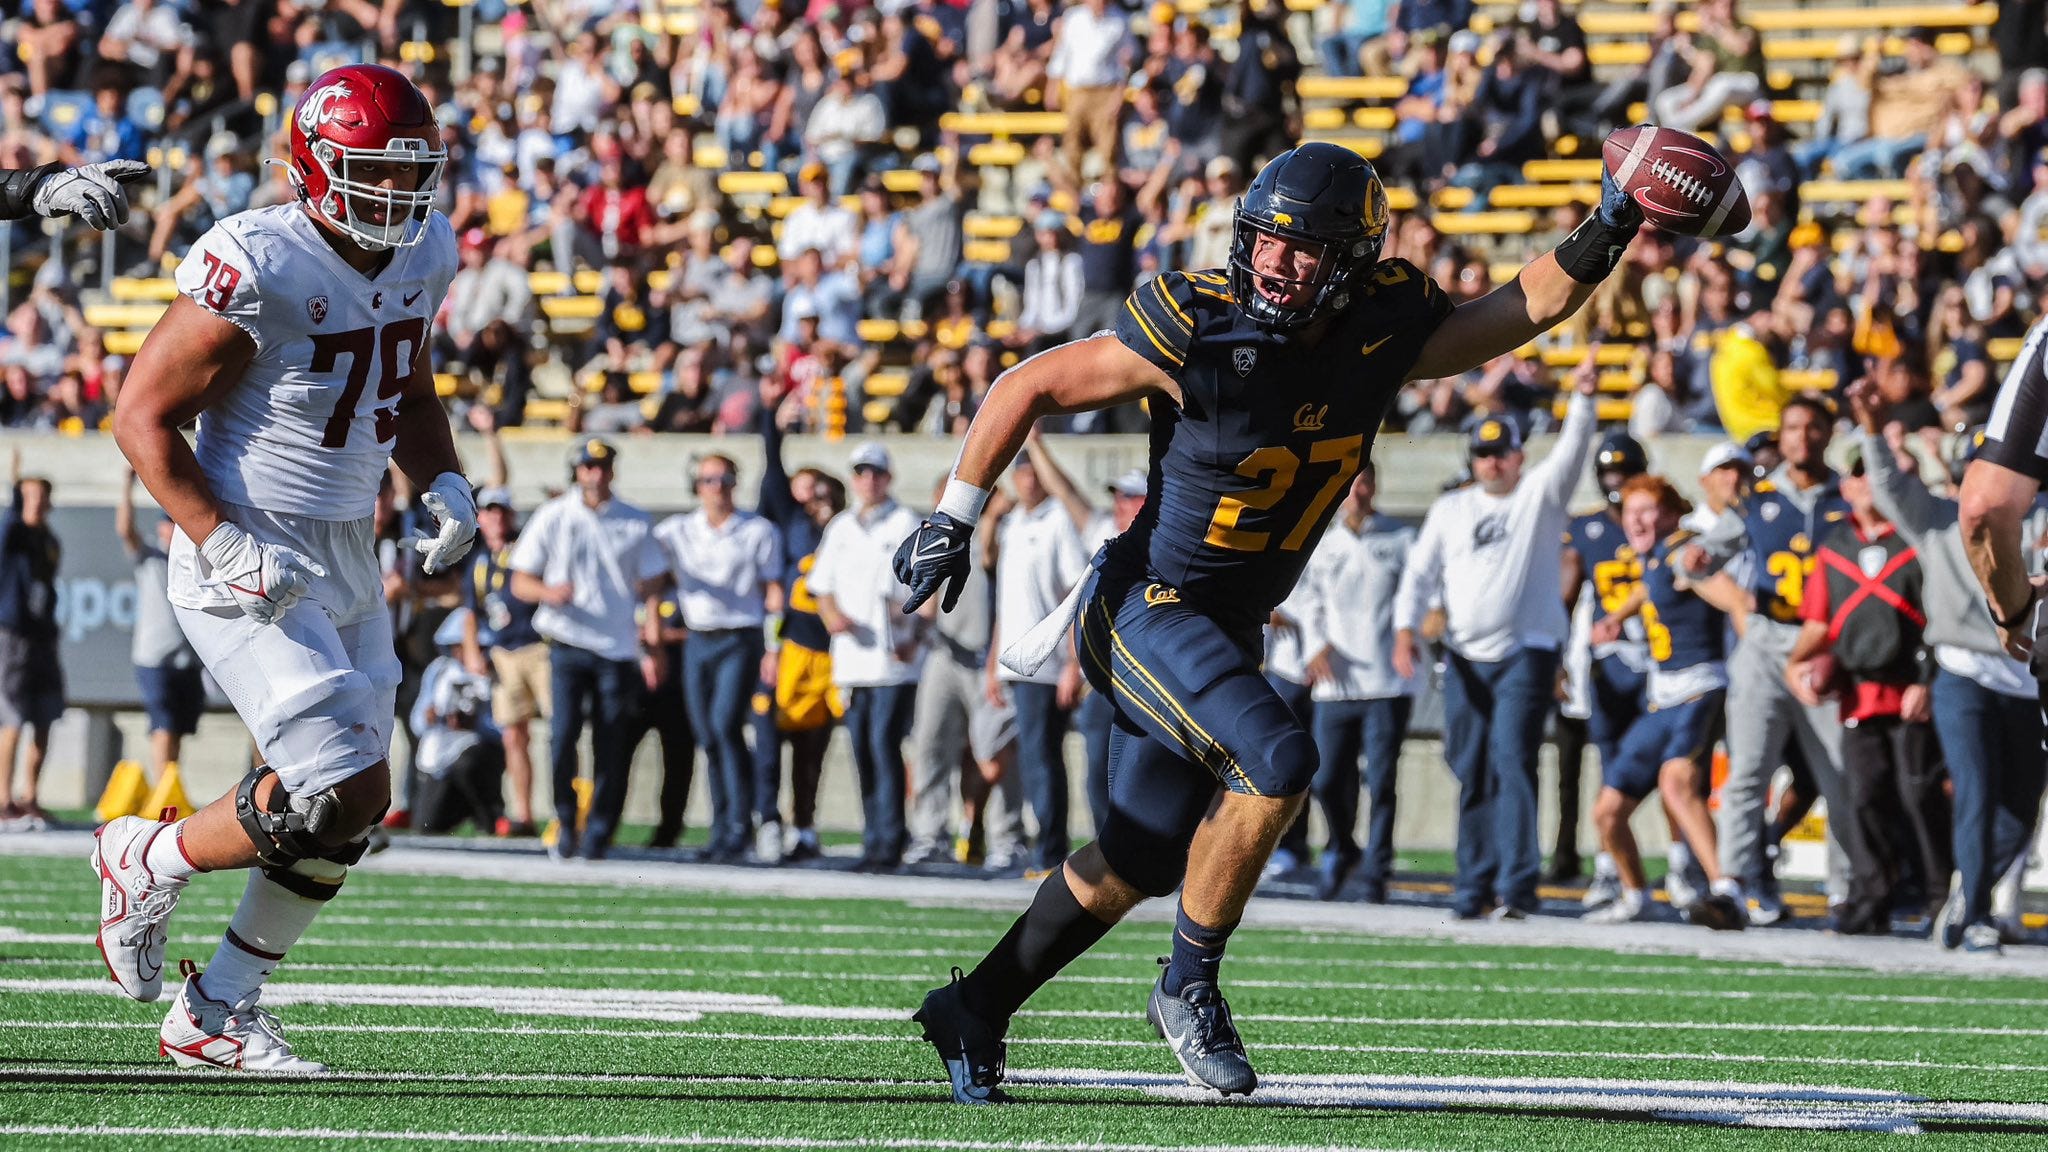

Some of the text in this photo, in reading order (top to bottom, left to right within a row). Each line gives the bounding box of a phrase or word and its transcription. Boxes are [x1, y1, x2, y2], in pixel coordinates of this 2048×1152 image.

[190, 249, 241, 312] 79
[309, 296, 327, 312] PAC
[313, 307, 324, 319] 12
[1233, 347, 1256, 365] PAC
[1238, 359, 1250, 371] 12
[307, 317, 425, 448] 79
[1292, 403, 1329, 433] Cal
[1203, 433, 1364, 551] 27
